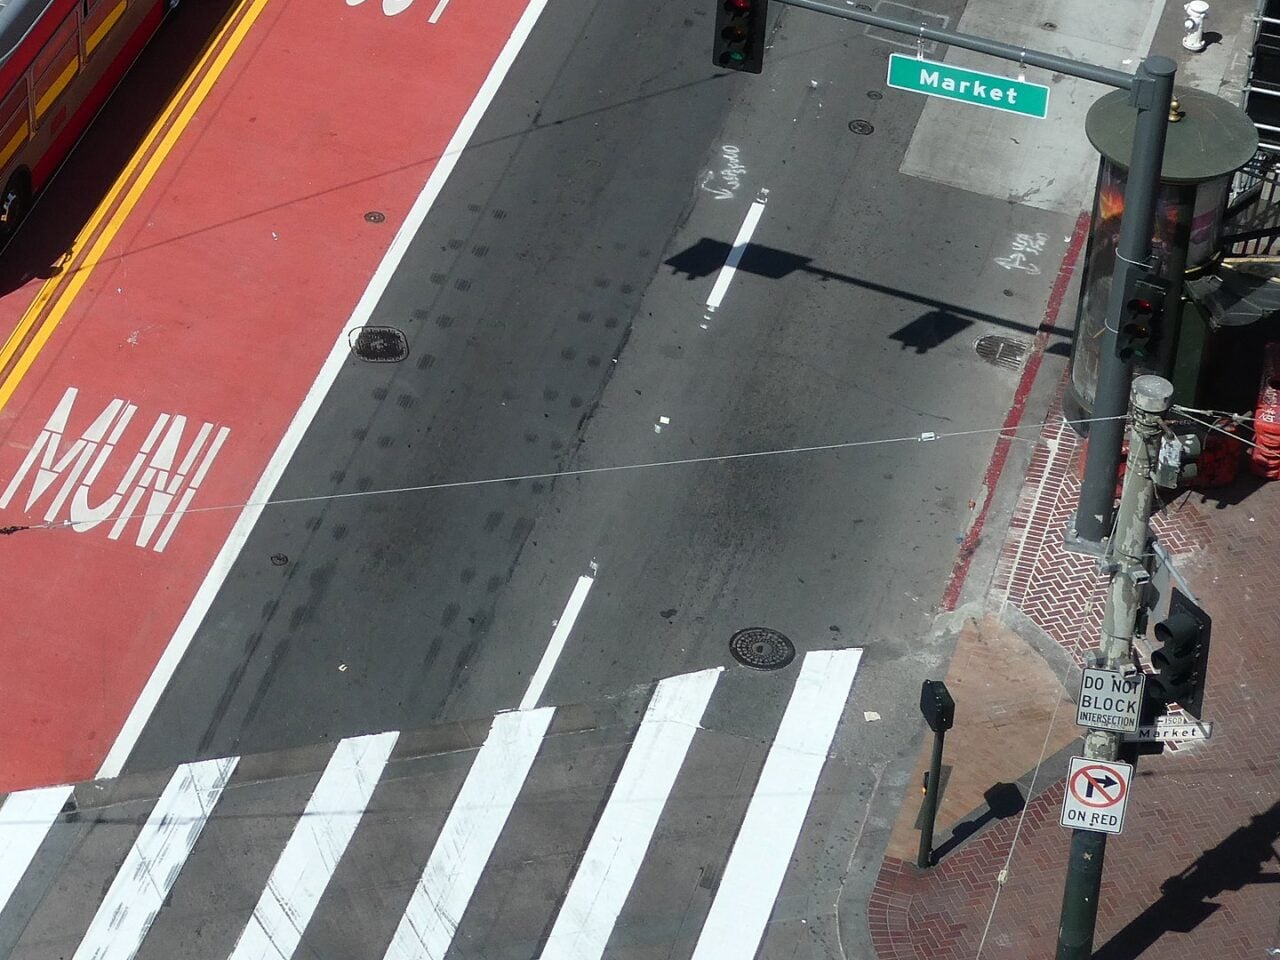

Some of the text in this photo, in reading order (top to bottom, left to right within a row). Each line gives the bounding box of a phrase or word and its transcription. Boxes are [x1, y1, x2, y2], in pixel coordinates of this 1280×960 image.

[919, 68, 1018, 105] Market
[1083, 675, 1141, 695] DO NOT
[1081, 695, 1137, 714] BLOCK
[1079, 711, 1136, 727] INTERSECTION
[1138, 726, 1197, 739] Market
[1067, 808, 1118, 827] ON RED
